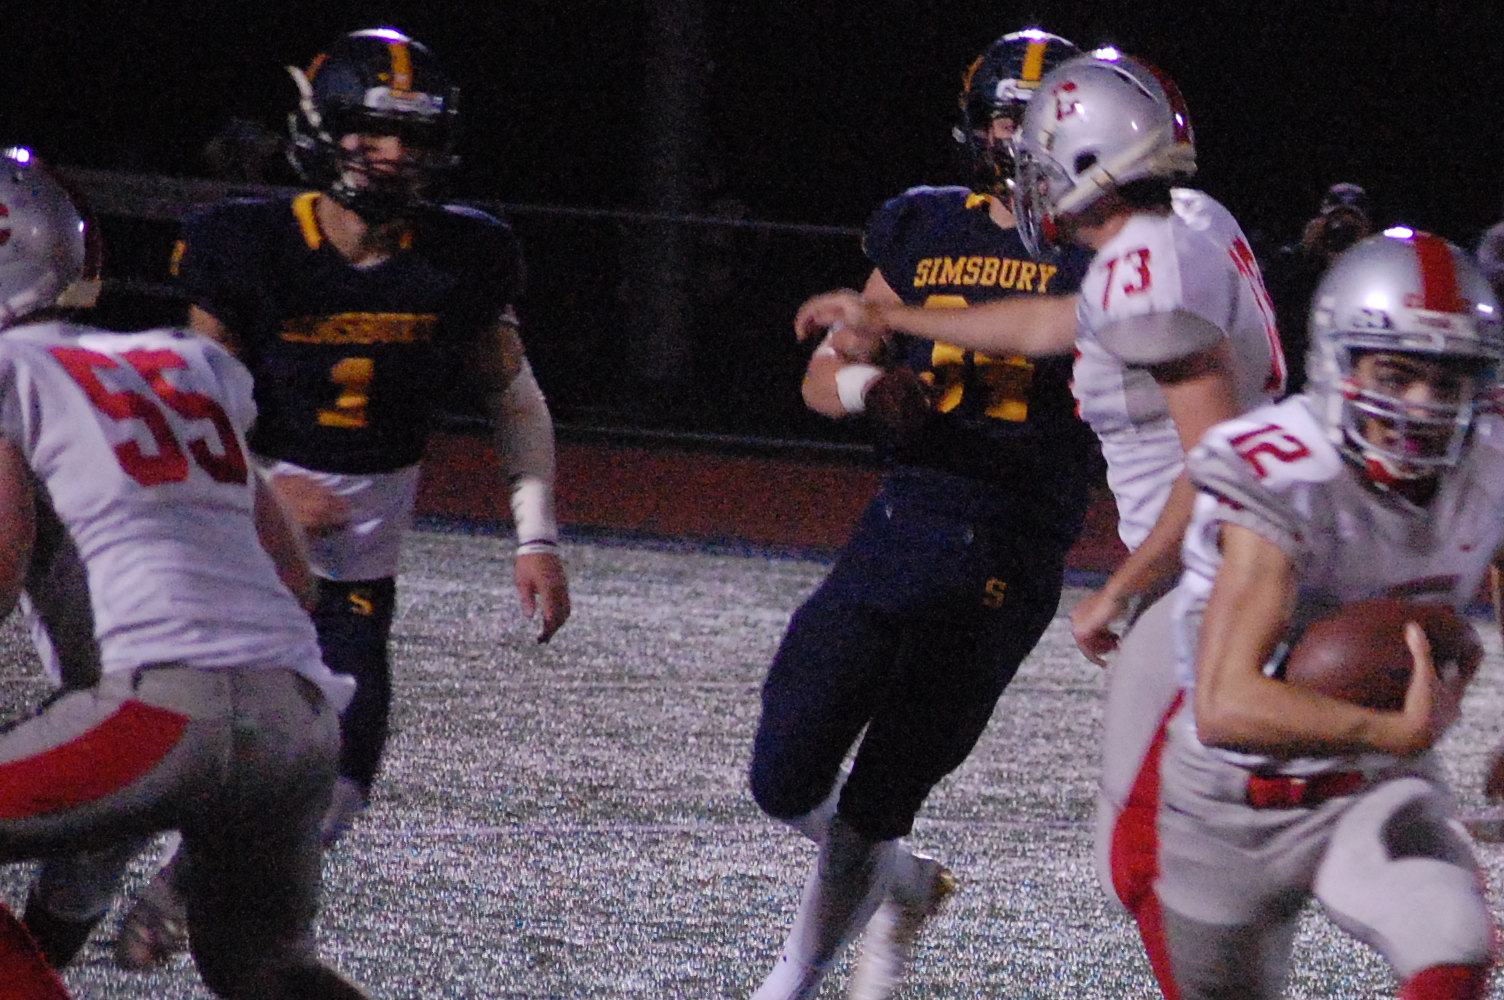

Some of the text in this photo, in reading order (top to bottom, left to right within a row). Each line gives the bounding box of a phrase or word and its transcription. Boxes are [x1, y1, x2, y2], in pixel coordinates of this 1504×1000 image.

[913, 255, 1058, 293] SIMSBURY
[1100, 247, 1152, 311] 73
[50, 346, 248, 486] 55
[1228, 423, 1312, 481] 12
